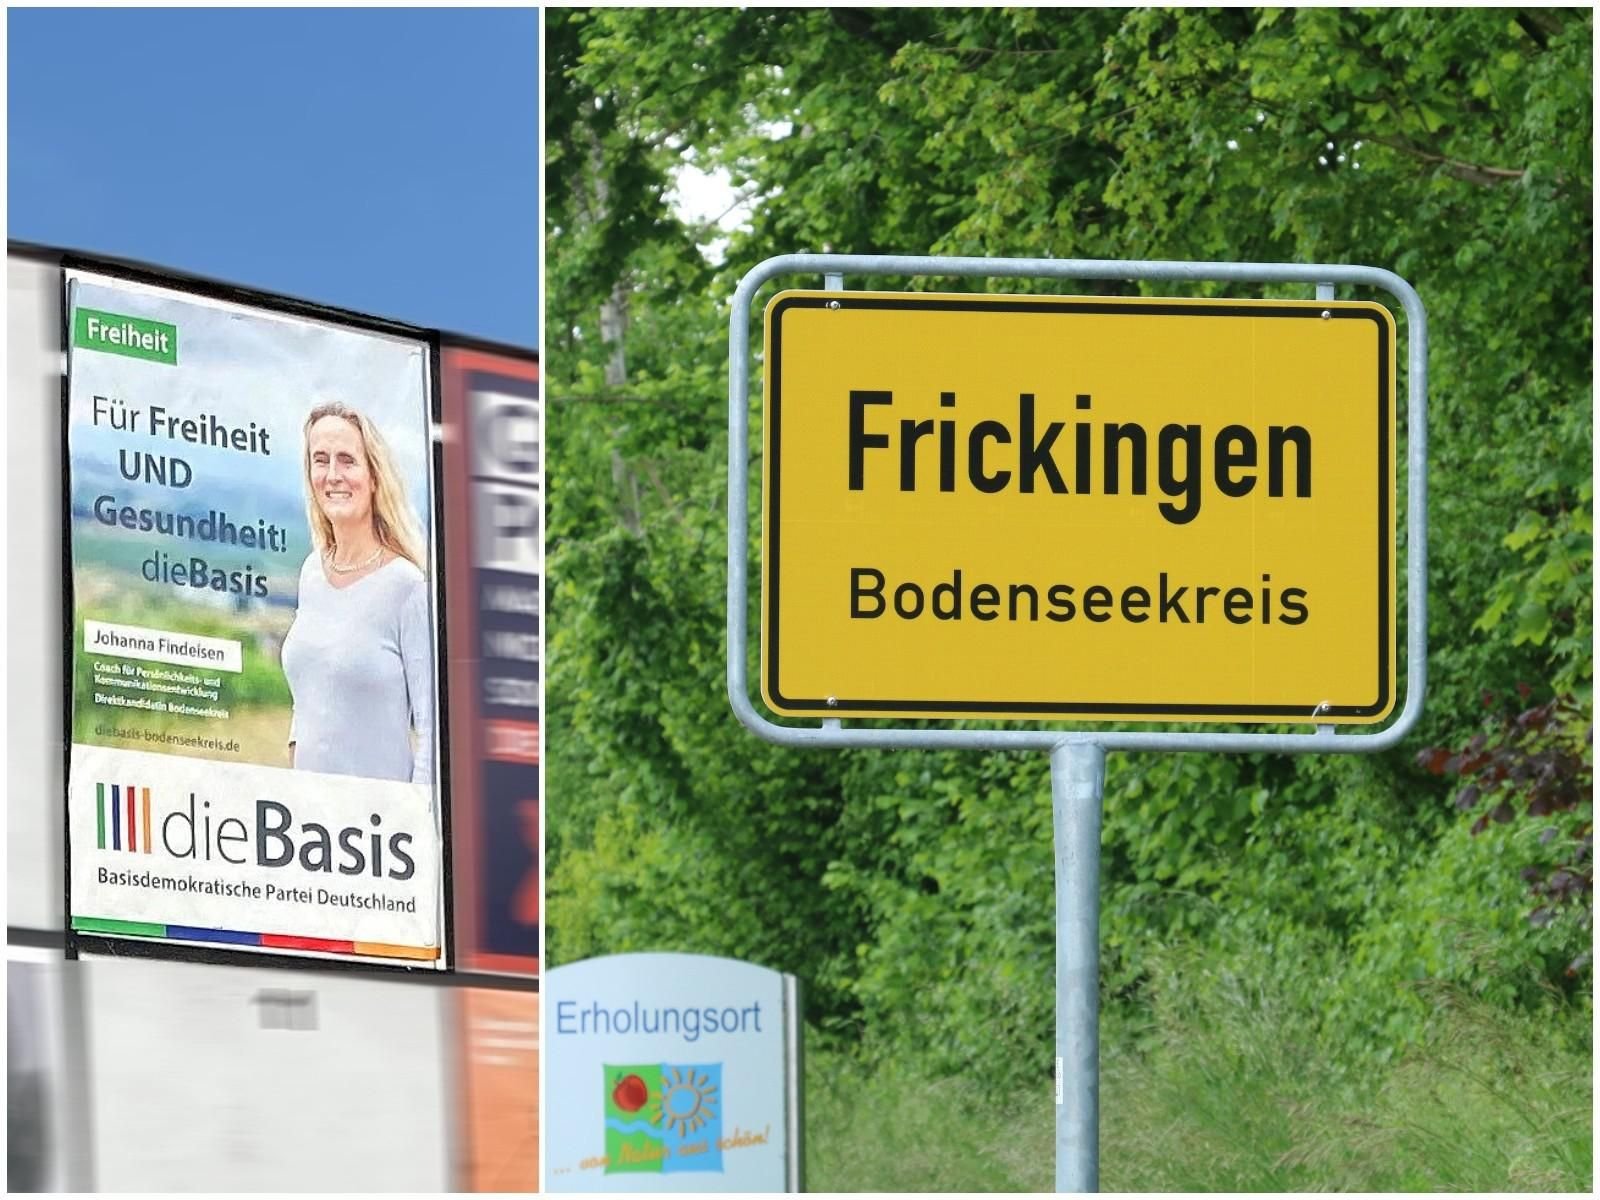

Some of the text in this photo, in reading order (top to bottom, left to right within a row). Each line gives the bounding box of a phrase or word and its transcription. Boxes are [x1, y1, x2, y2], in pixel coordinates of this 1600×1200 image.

[86, 317, 169, 354] Freiheit
[92, 396, 271, 456] Für Freiheit
[119, 449, 193, 489] UND
[847, 390, 1313, 525] Frickingen
[93, 495, 288, 553] Gesundheit!
[141, 551, 269, 599] dieBasis
[849, 568, 1310, 625] Bodenseekreis
[94, 629, 225, 662] Johanna Findeisen
[93, 661, 121, 674] Coach
[122, 664, 135, 676] für
[203, 676, 221, 688] und
[94, 693, 230, 720] Direktkandidatin Bodenseekreis
[162, 792, 415, 880] dieBasis
[97, 867, 417, 914] Basisdemokratische Partei Deutschland
[556, 1000, 763, 1041] Erholungsort
